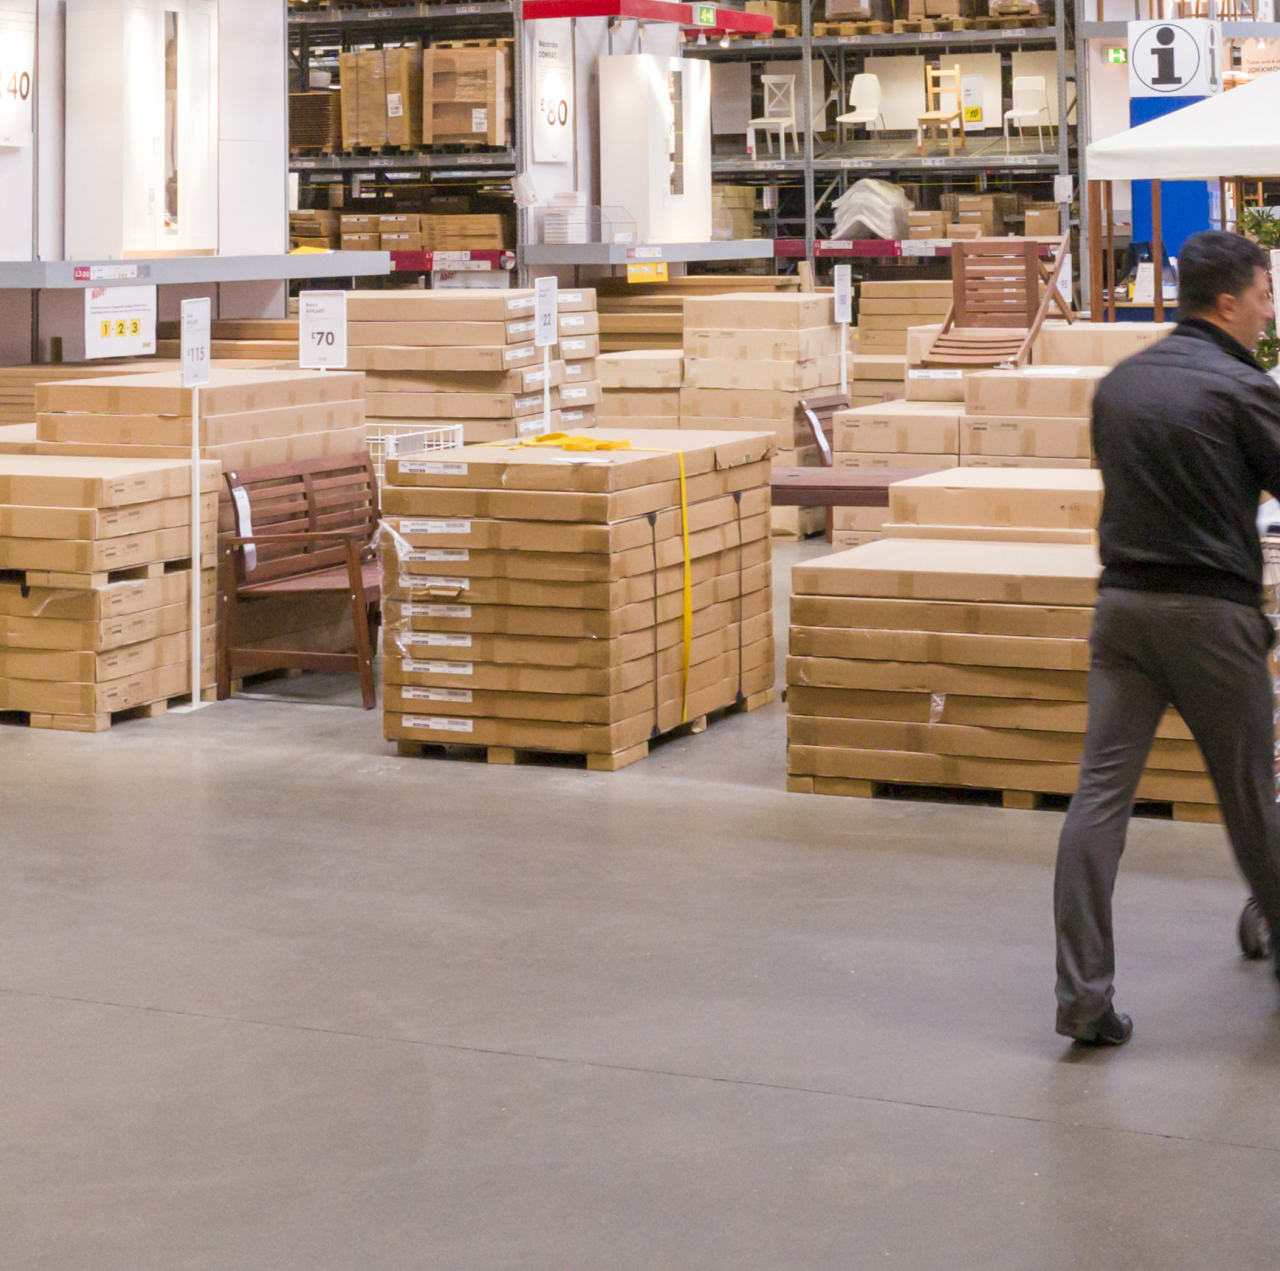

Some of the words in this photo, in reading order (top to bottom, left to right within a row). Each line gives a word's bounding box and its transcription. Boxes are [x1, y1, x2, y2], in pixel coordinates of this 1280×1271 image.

[118, 323, 124, 334] 2
[131, 322, 138, 334] 3
[312, 331, 335, 346] £70
